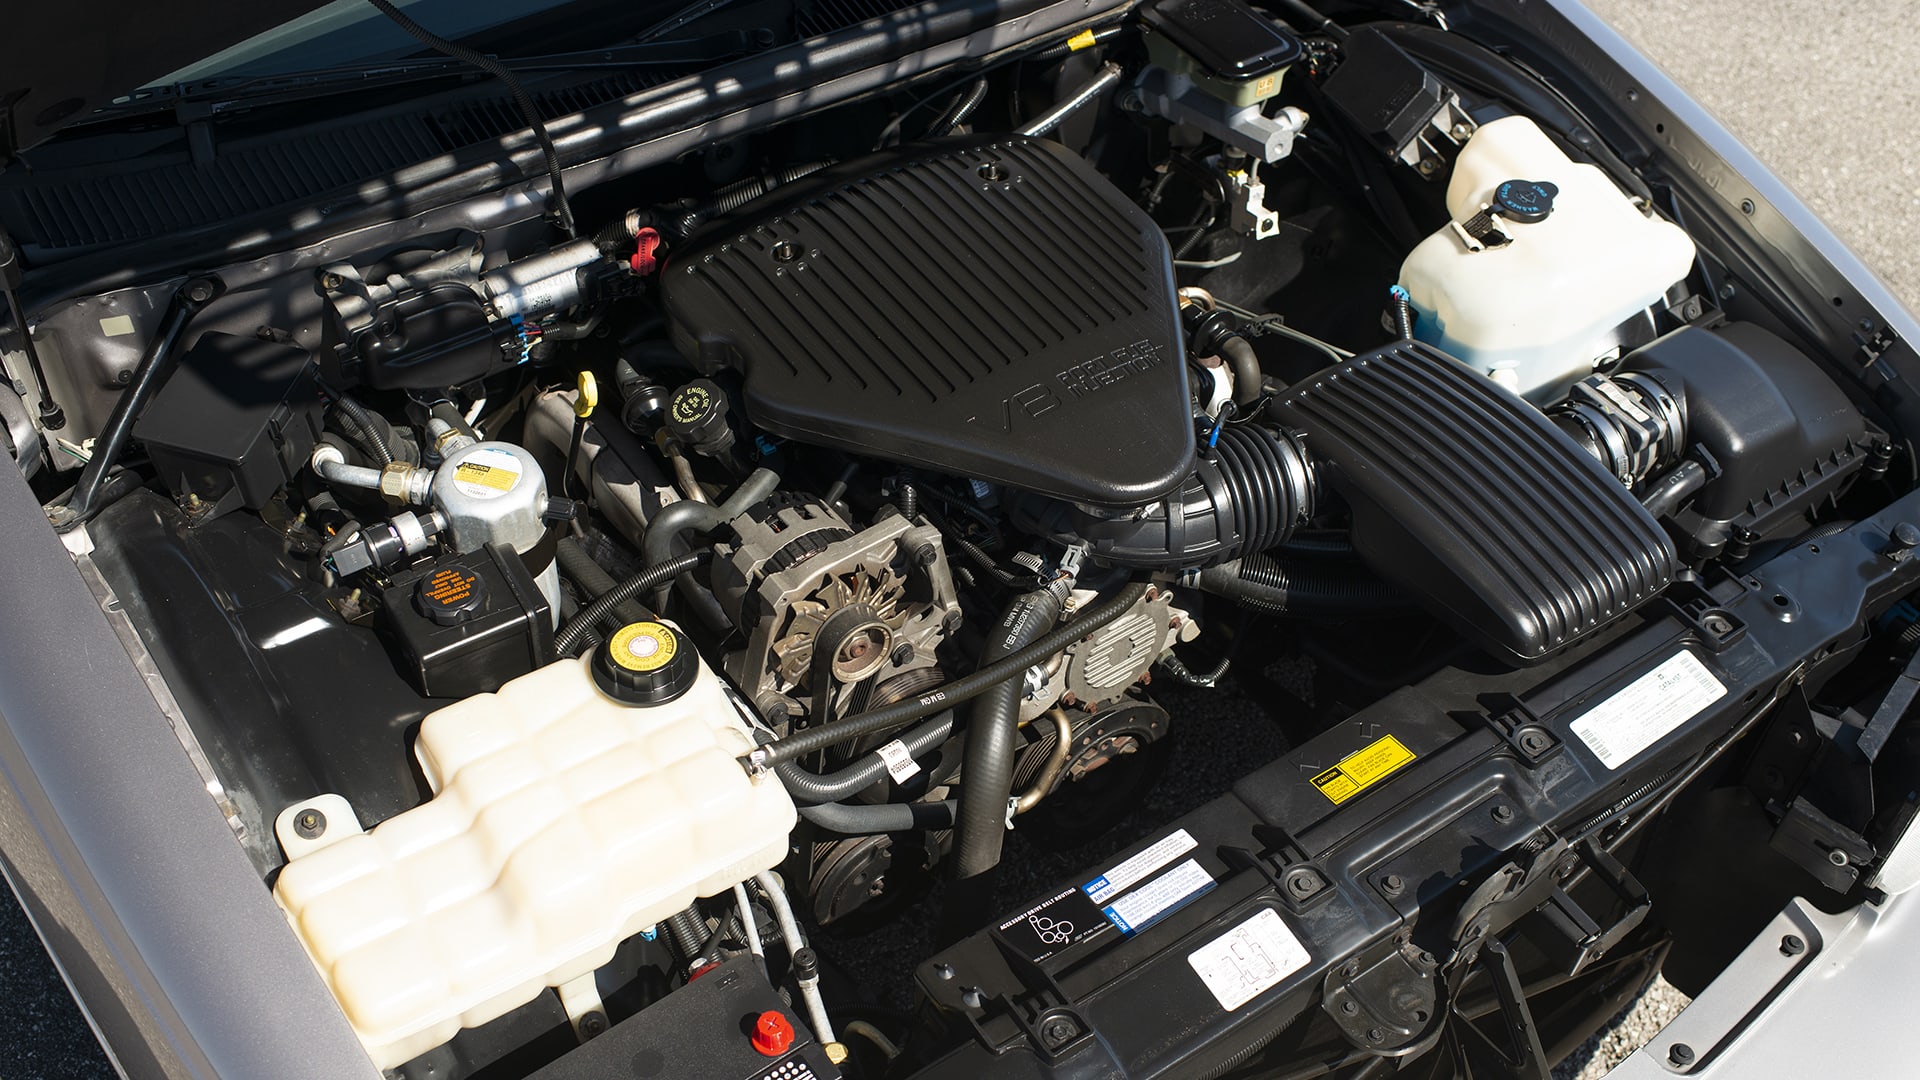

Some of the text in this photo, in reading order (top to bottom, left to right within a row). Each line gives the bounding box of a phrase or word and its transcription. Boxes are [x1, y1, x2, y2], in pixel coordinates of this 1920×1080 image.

[1500, 184, 1511, 198] FLUID
[1532, 185, 1547, 197] ONLY
[1506, 200, 1538, 212] WASHER
[1067, 352, 1165, 399] INJECTION
[687, 387, 709, 398] ENGINE
[702, 399, 710, 408] OIL
[682, 413, 702, 423] MANUAL
[469, 464, 490, 472] CAUTION
[431, 572, 459, 584] APPROVED
[436, 569, 451, 578] FLUID
[424, 585, 451, 597] OVERFILL
[434, 580, 448, 589] ONLY
[434, 584, 470, 600] STEERING
[442, 591, 470, 605] POWER
[1659, 674, 1682, 690] CATALYST
[920, 696, 931, 706] GM
[1318, 771, 1338, 784] CAUTION
[1154, 870, 1176, 884] COOLANT
[1177, 863, 1189, 872] ONLY
[1087, 879, 1108, 893] NOTICE
[1103, 887, 1115, 896] BAG
[1000, 887, 1076, 930] ACCESSORY DRIVE BELT ROUTING
[1109, 912, 1128, 930] NOTICE
